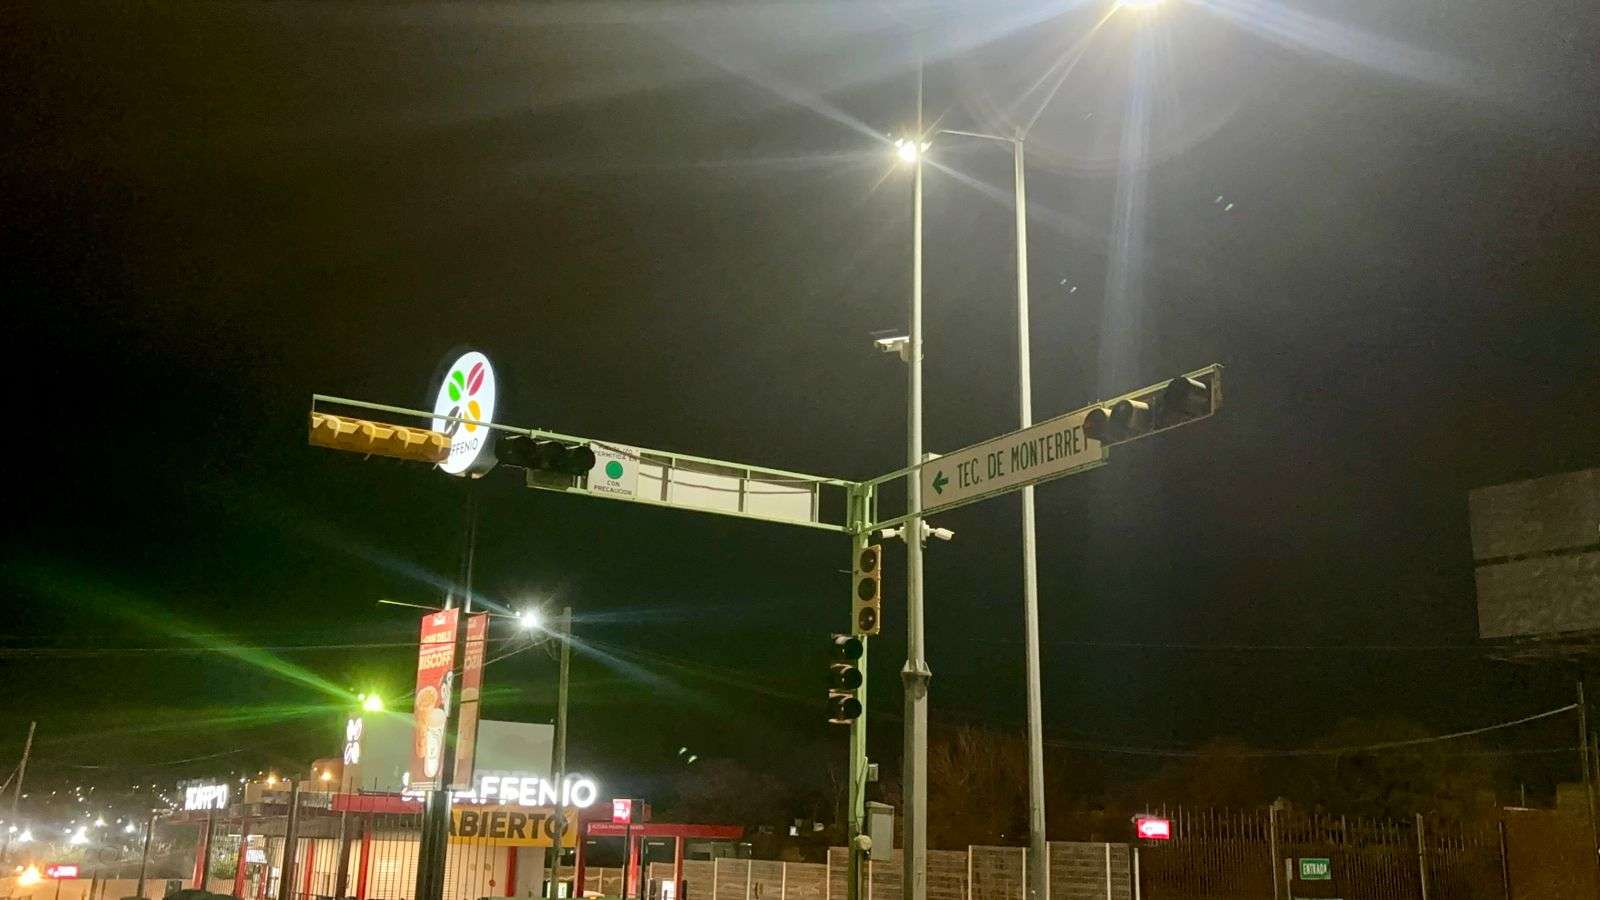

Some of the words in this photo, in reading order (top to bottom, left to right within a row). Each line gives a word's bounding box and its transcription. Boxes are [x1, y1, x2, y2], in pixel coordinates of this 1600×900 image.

[450, 437, 479, 456] FFENIO
[956, 457, 983, 489] TEC.
[987, 450, 1004, 480] DE
